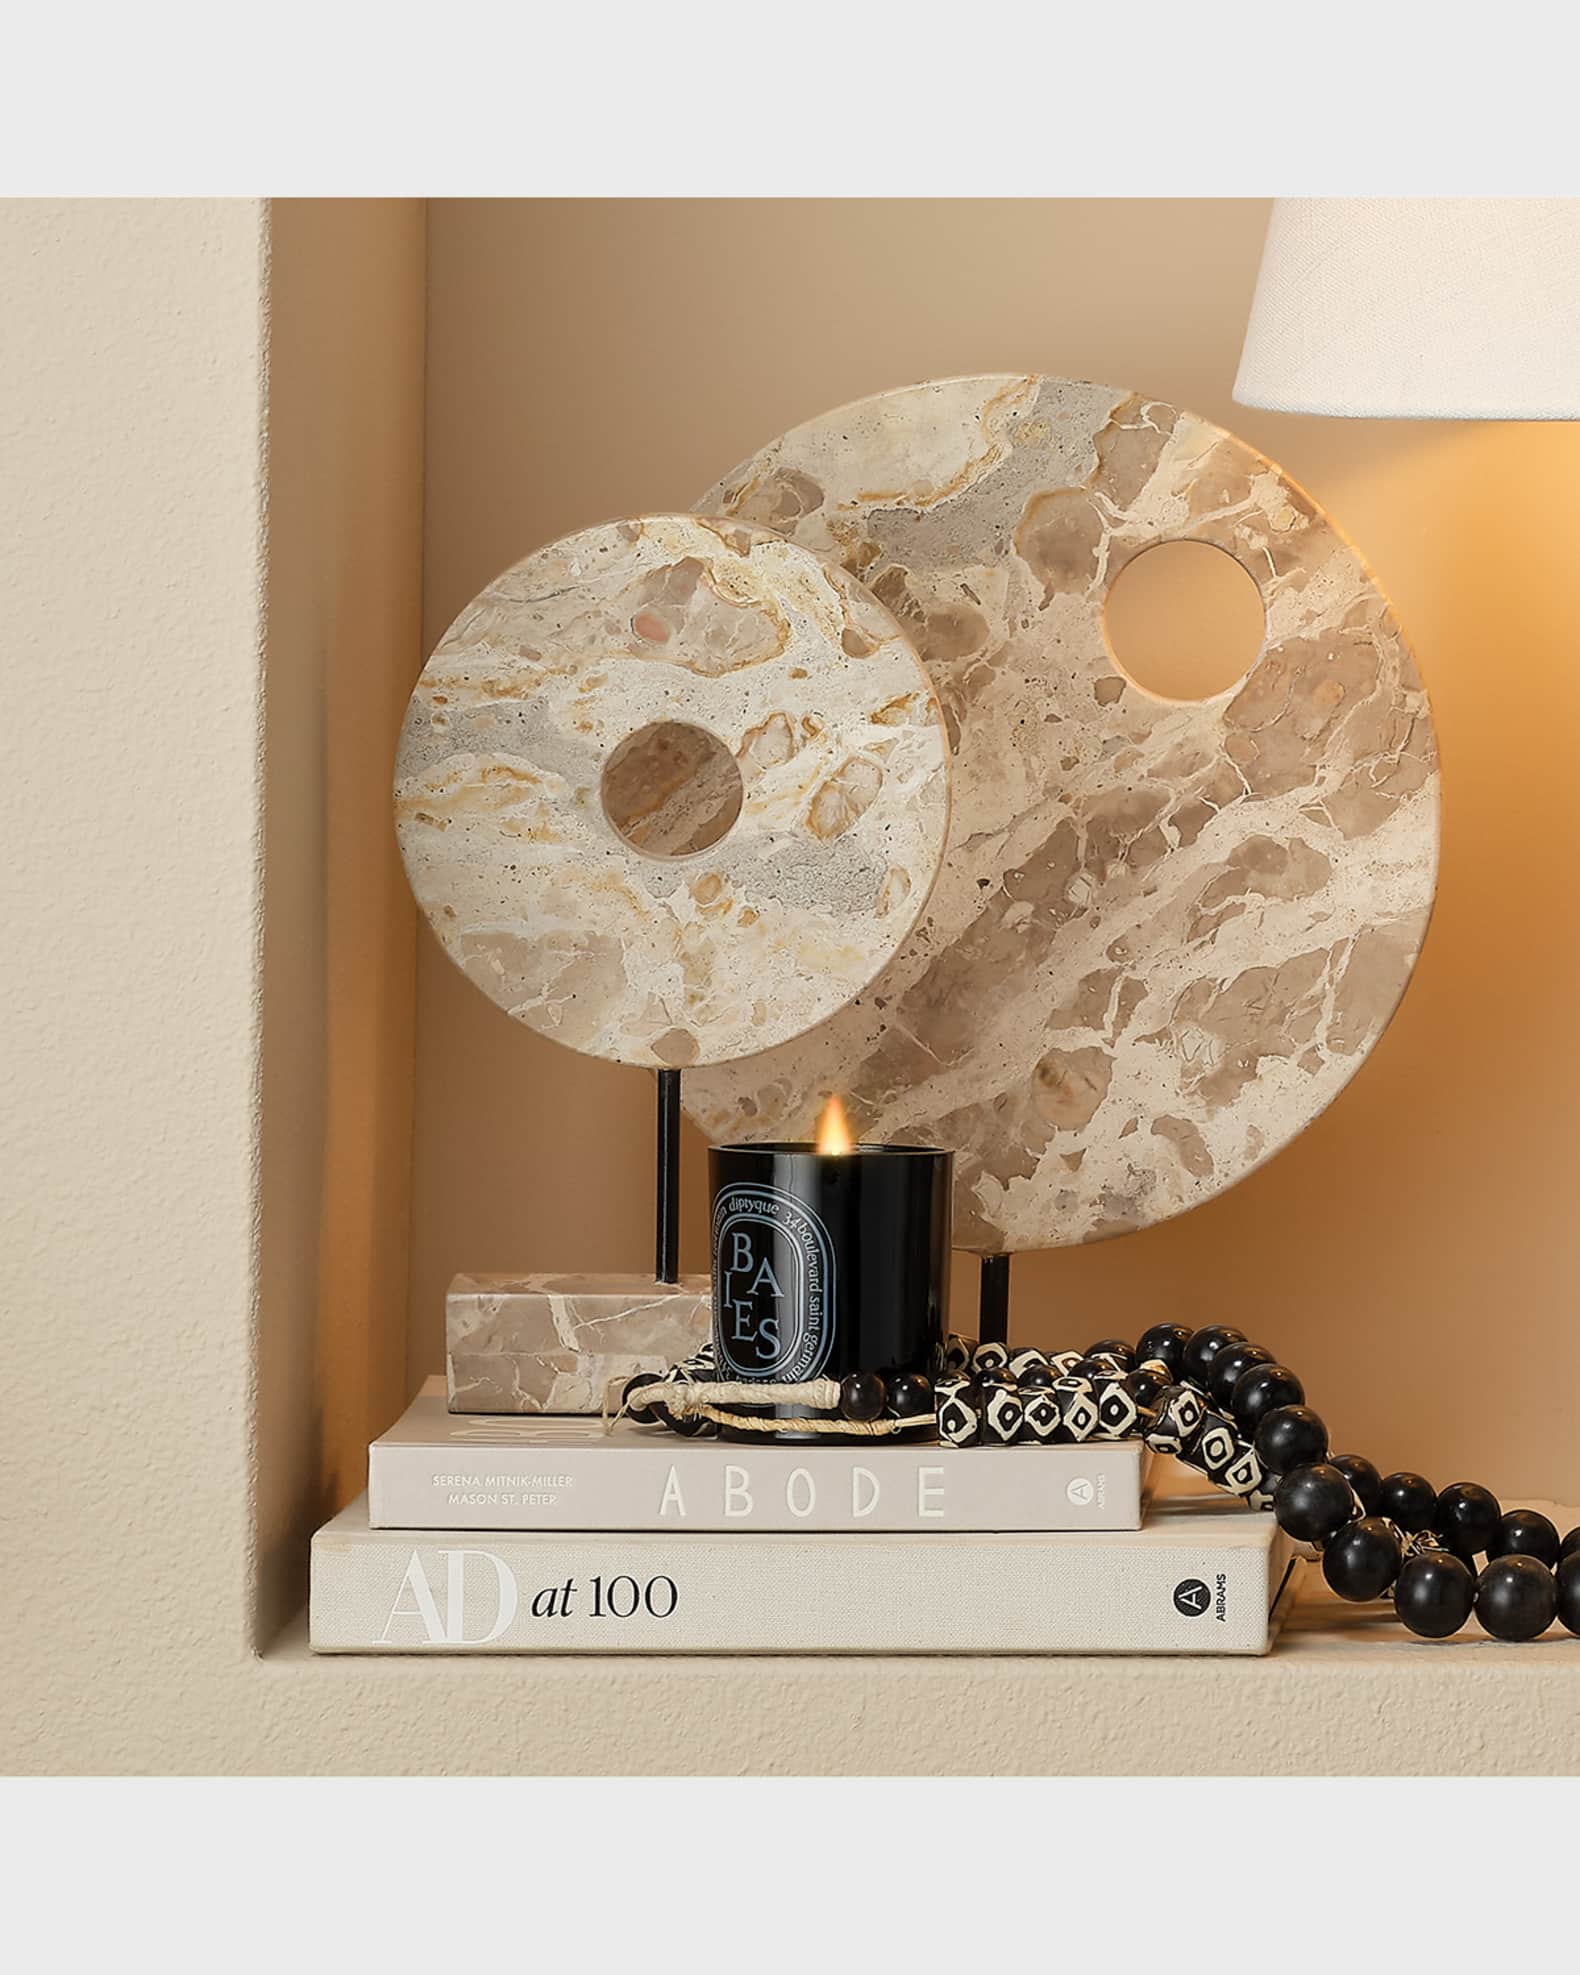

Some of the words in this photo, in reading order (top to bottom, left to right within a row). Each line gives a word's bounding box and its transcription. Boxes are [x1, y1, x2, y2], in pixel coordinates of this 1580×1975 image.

[728, 1197, 780, 1215] diptyque
[782, 1211, 802, 1230] 34
[798, 1221, 823, 1292] boulevard
[808, 1295, 824, 1331] saint
[781, 1332, 819, 1384] germain
[432, 1475, 481, 1488] SERENA
[484, 1475, 574, 1488] MITNIK-MILLER
[448, 1493, 498, 1506] MASON
[501, 1493, 519, 1506] ST.
[522, 1493, 557, 1506] PETER
[659, 1464, 946, 1518] ABODE
[372, 1549, 518, 1645] AD
[531, 1578, 579, 1618] at
[588, 1575, 679, 1618] 100
[1215, 1573, 1227, 1622] ABRAMS
